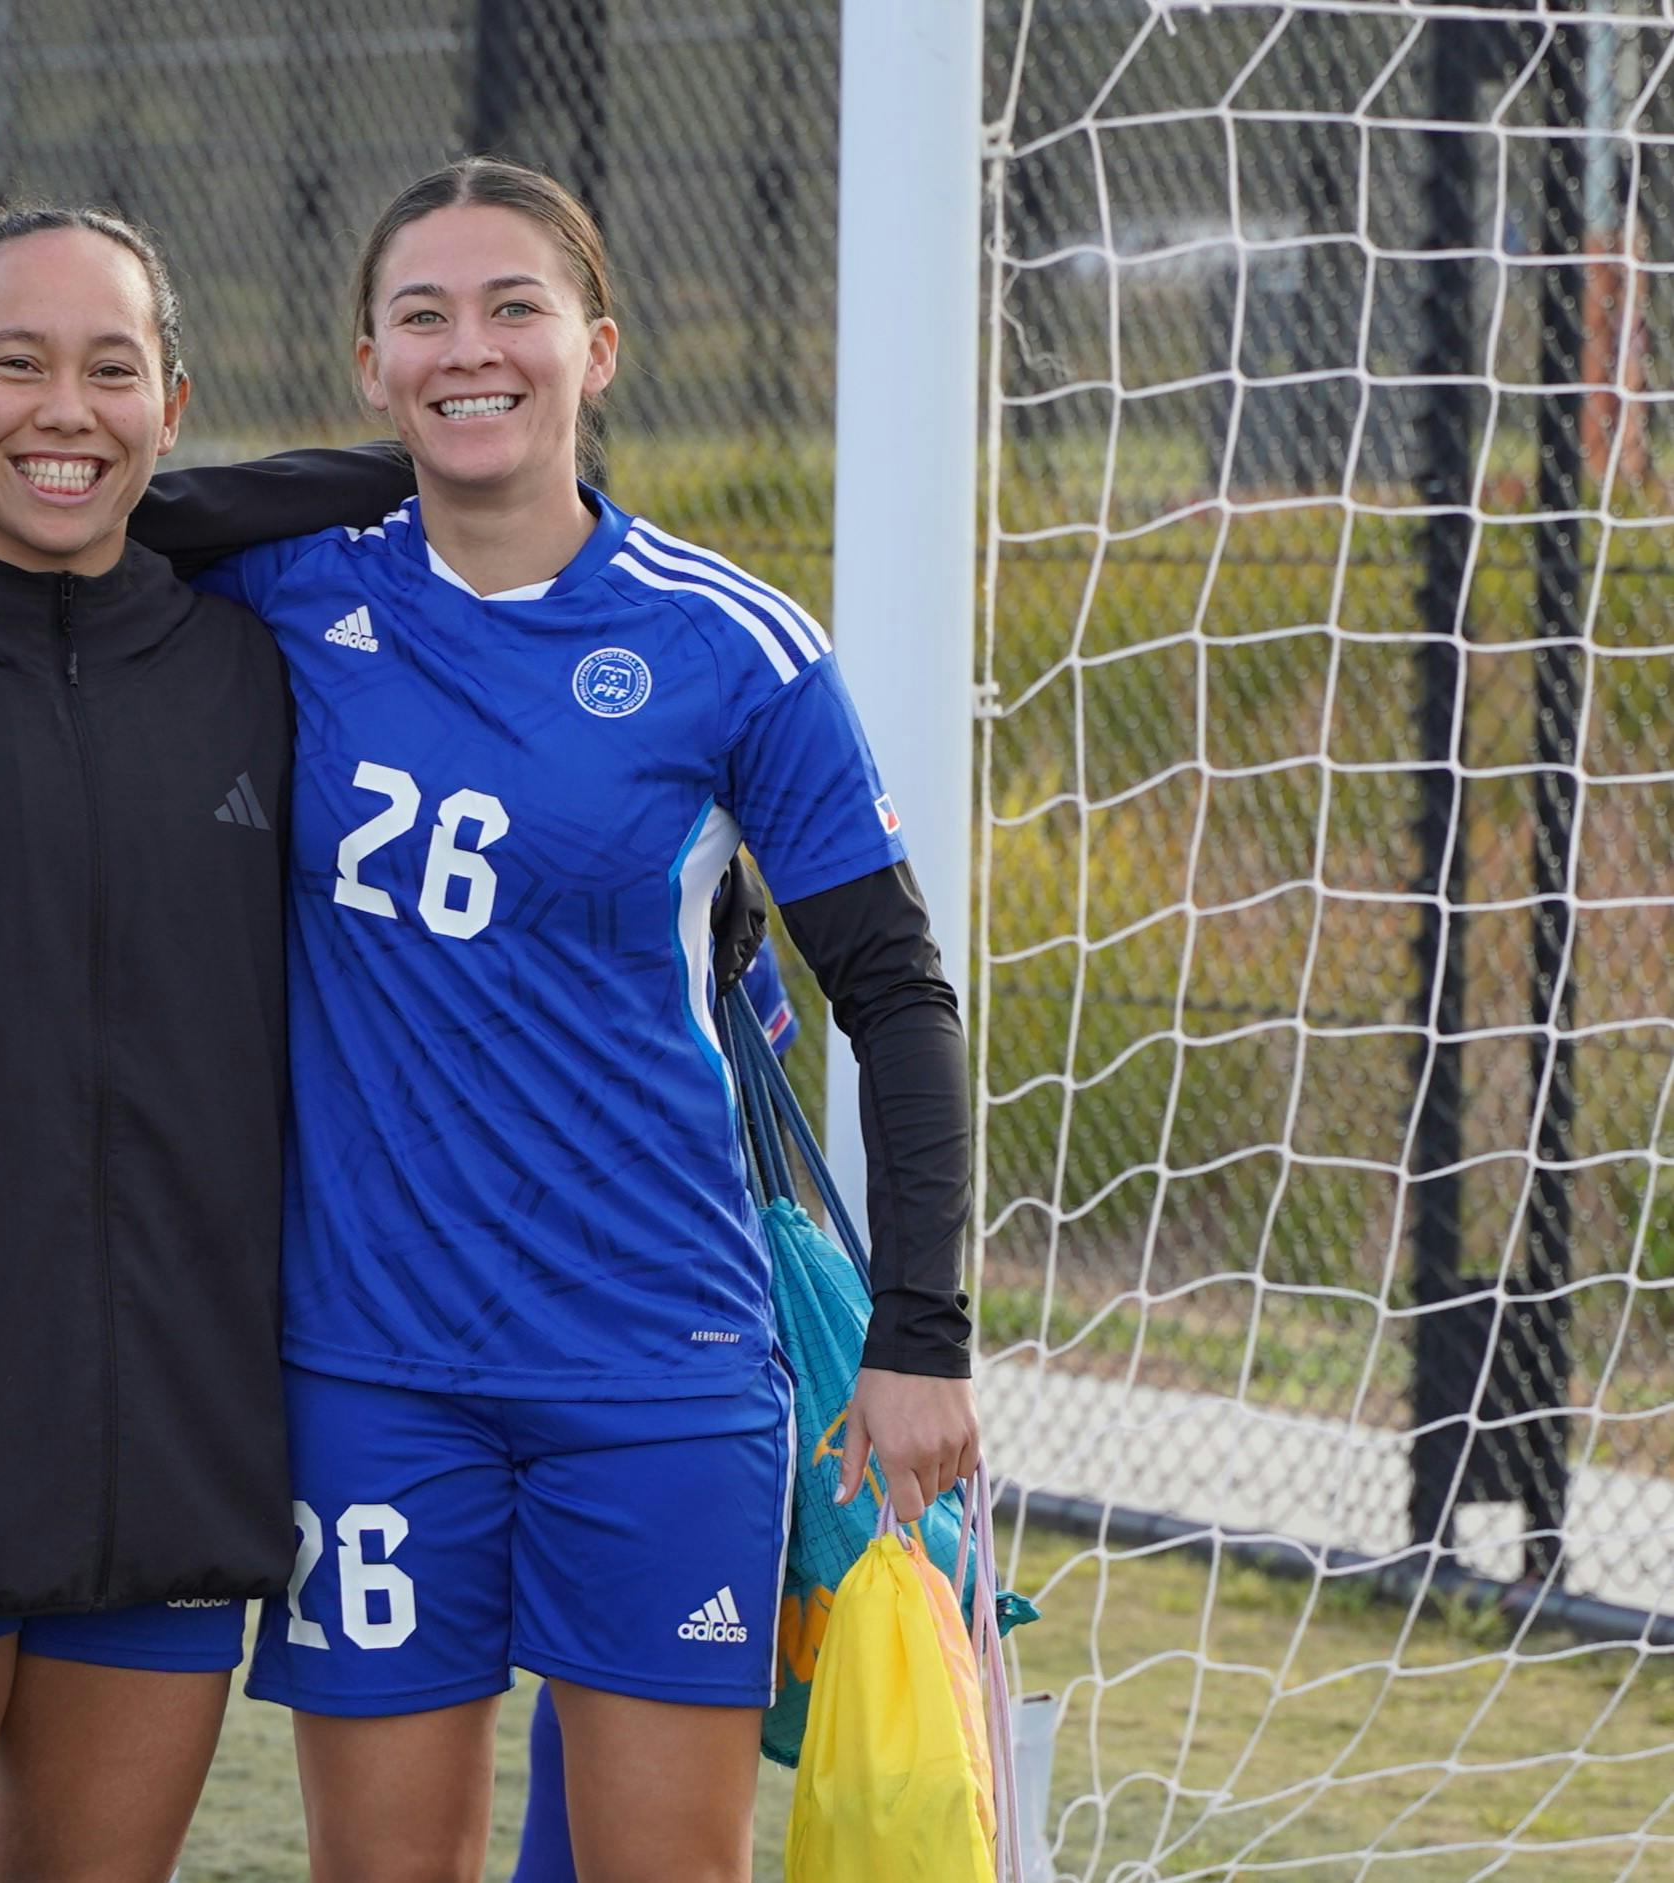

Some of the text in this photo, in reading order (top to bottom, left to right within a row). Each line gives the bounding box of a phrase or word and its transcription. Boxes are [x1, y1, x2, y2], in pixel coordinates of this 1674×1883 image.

[324, 628, 379, 653] adidas
[595, 652, 637, 666] FOOTBALL
[592, 684, 630, 699] PFF
[333, 760, 511, 940] 26
[690, 1330, 741, 1344] AEROREADY
[287, 1499, 418, 1651] 26
[677, 1620, 748, 1643] adidas
